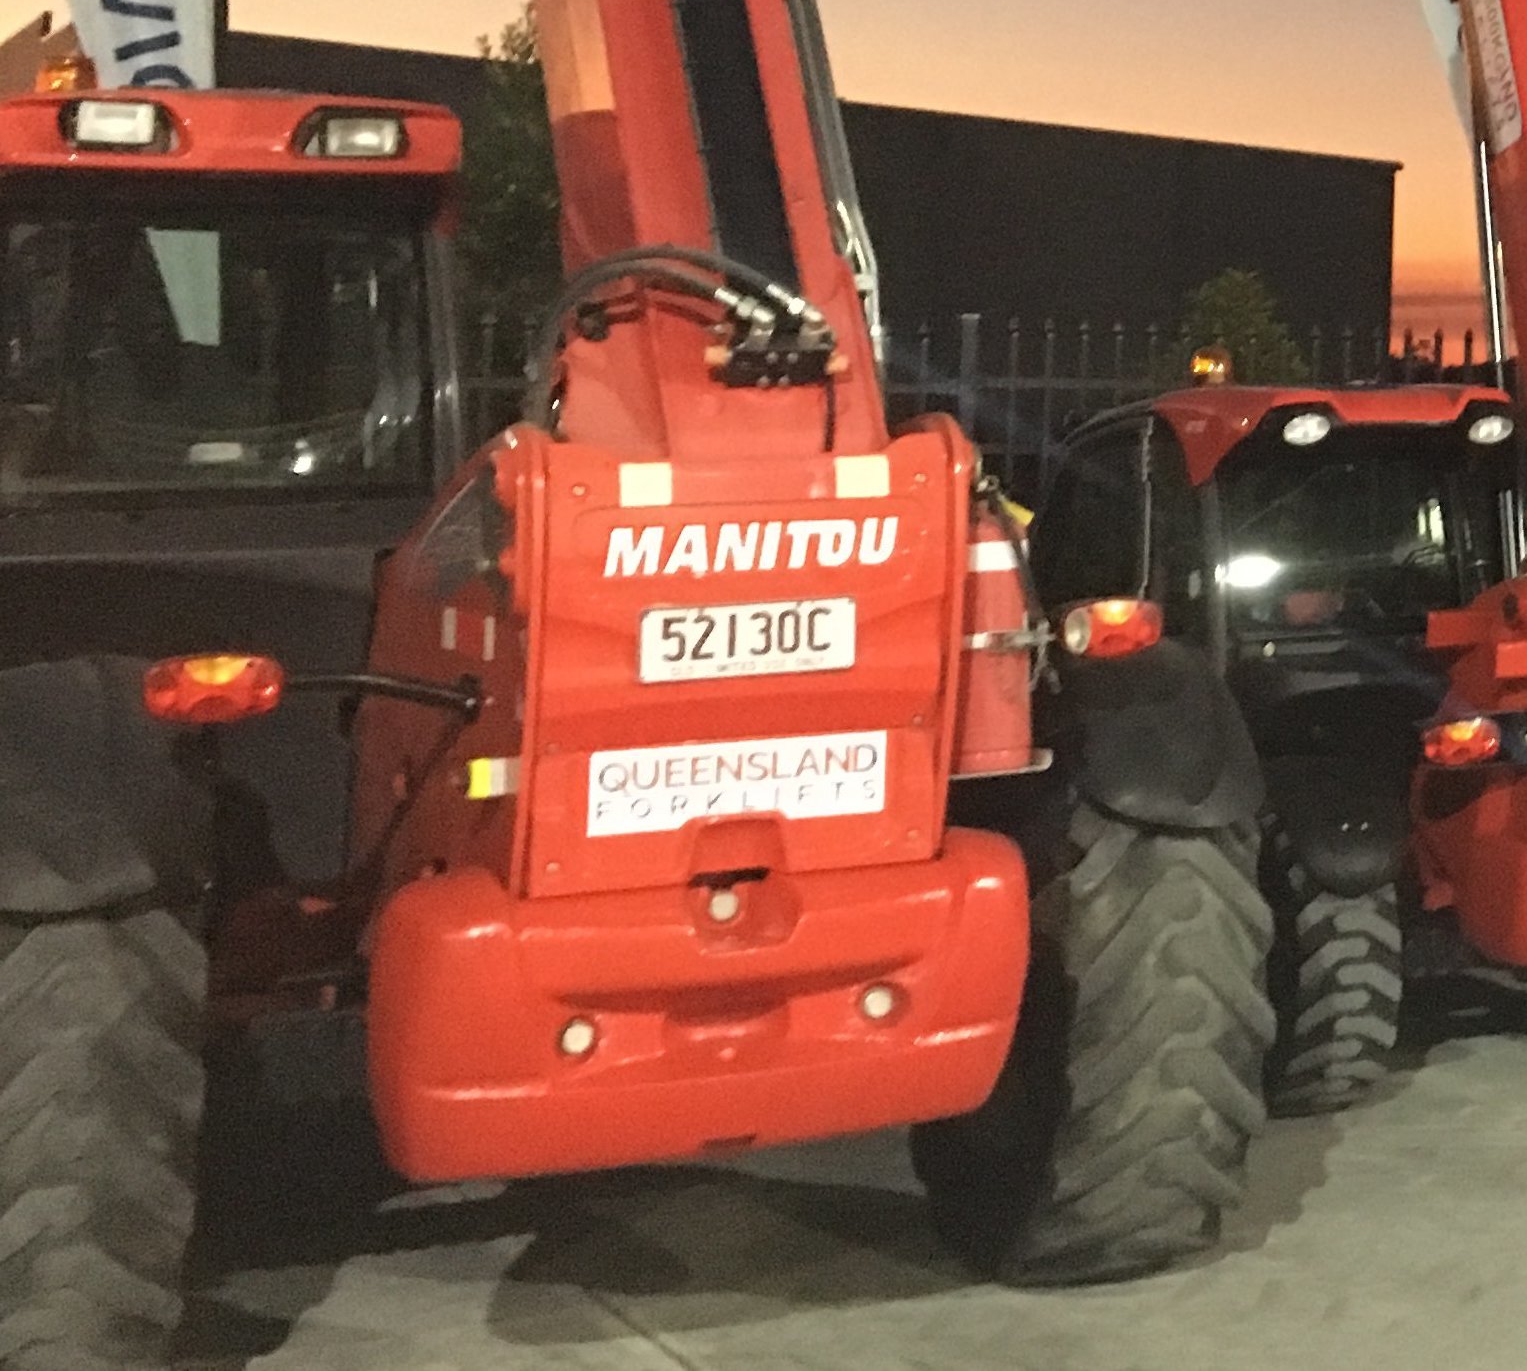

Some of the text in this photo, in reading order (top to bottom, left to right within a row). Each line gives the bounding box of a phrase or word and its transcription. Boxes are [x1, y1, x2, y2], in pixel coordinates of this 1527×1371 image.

[602, 516, 899, 578] MANITOU
[661, 605, 833, 663] 52130C
[597, 742, 879, 796] QUEENSLAND
[595, 779, 879, 820] FORKLIFTS
